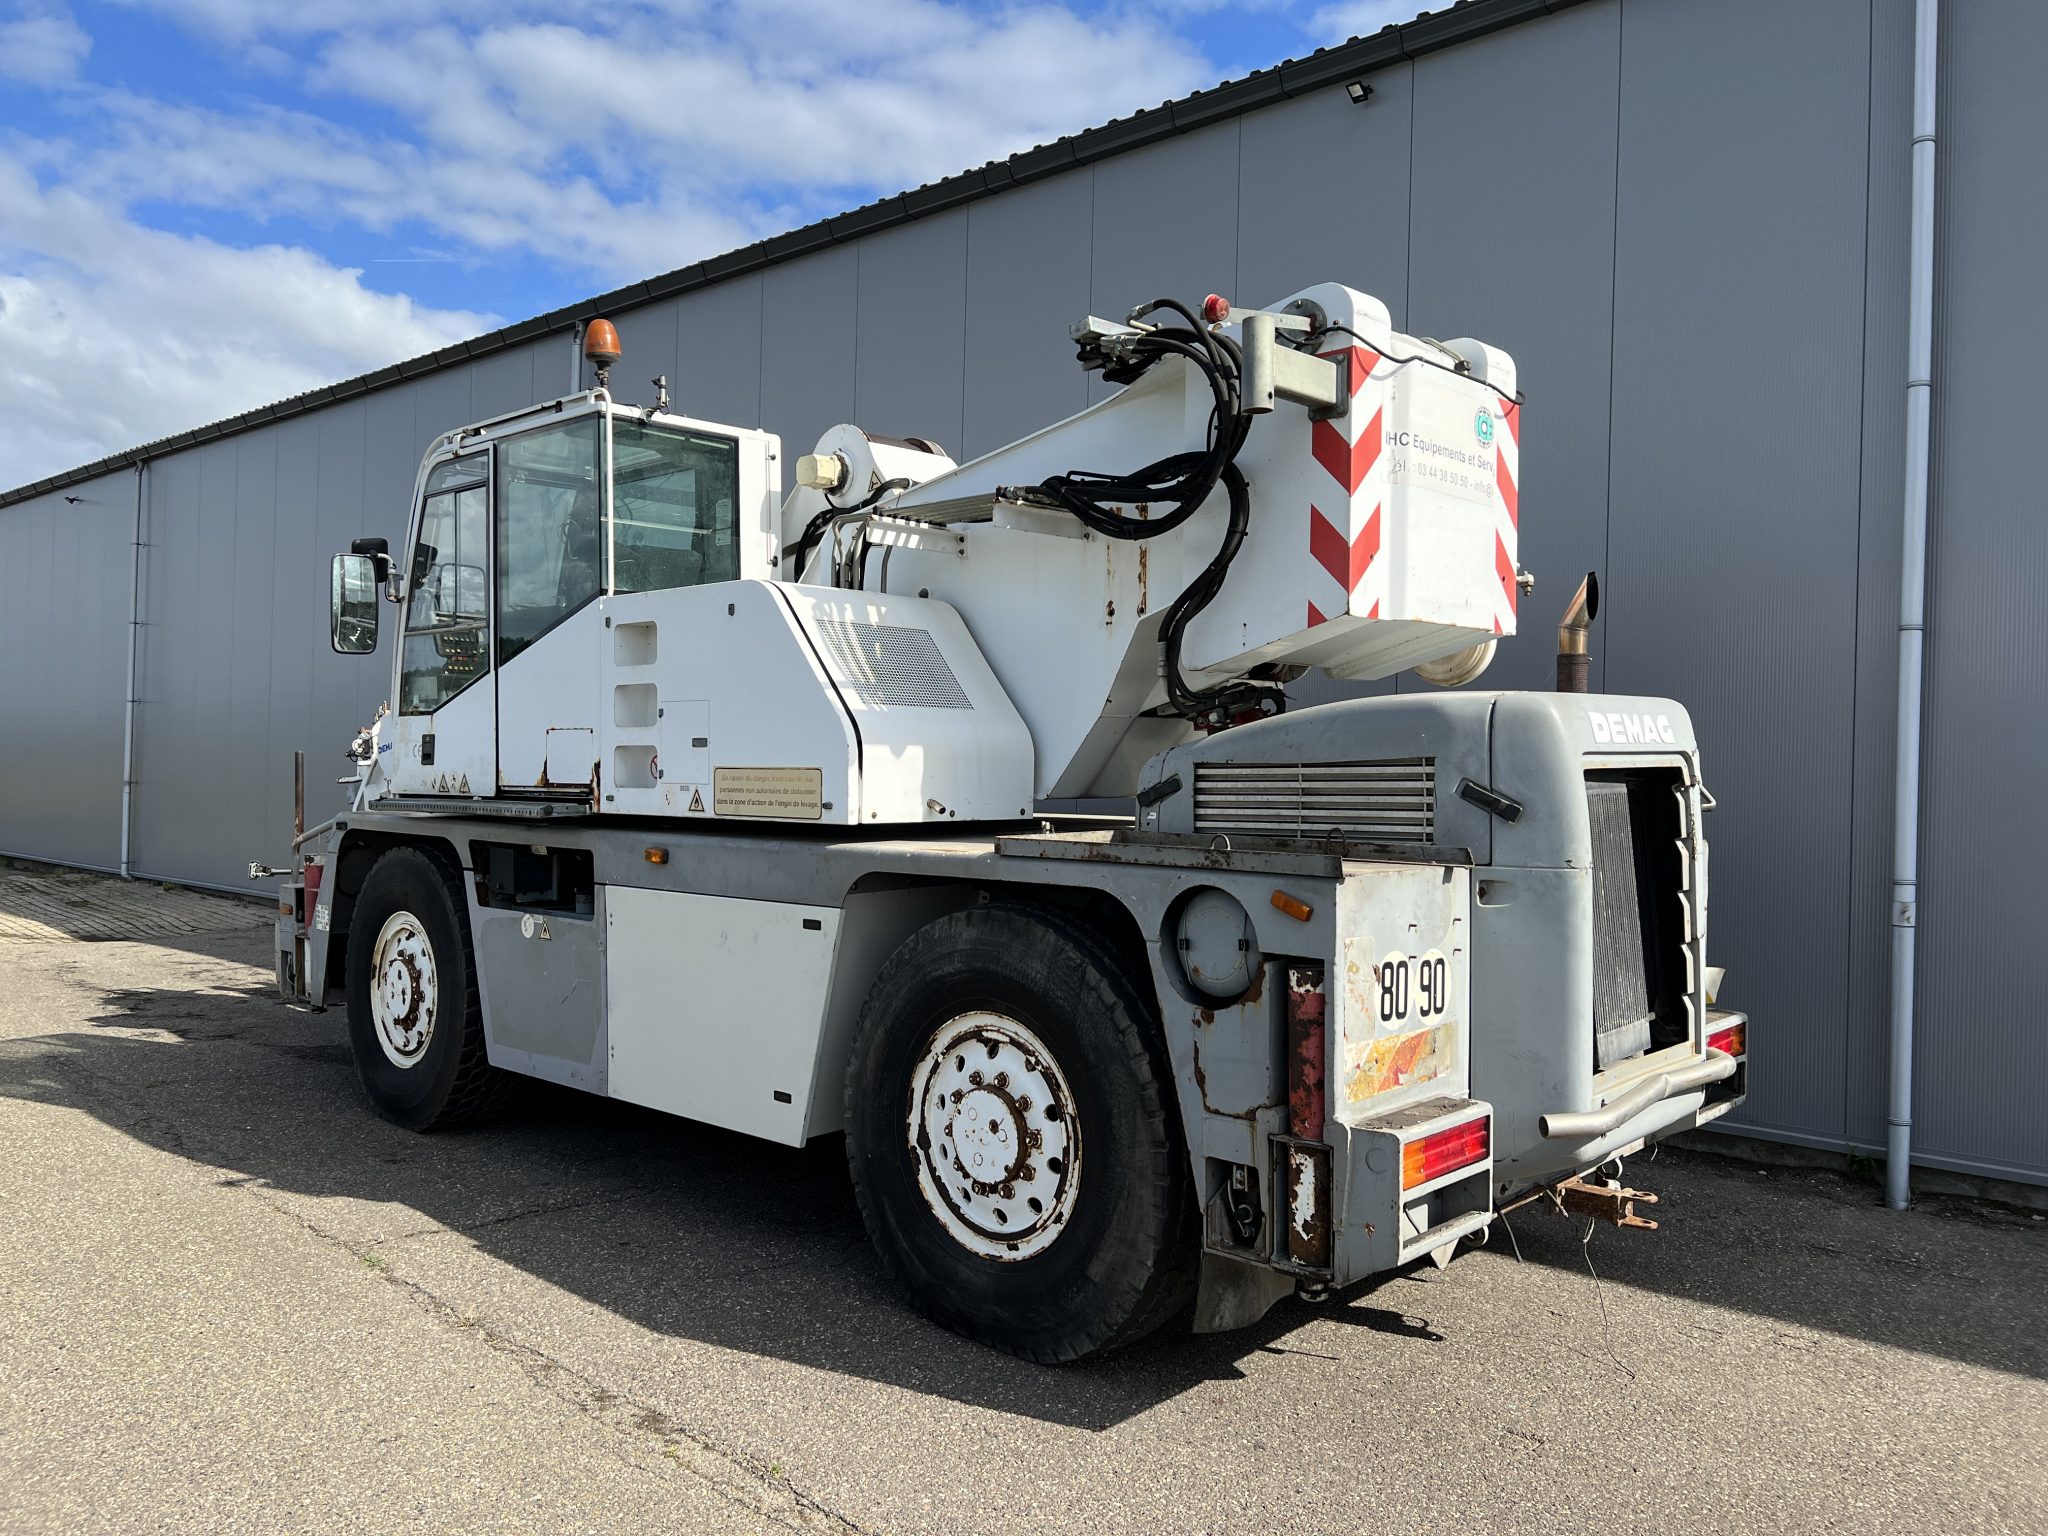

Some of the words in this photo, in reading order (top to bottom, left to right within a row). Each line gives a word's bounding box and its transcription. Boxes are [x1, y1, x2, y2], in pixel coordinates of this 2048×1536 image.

[1385, 431, 1410, 446] IHC
[1413, 434, 1466, 463] Equipements
[1468, 454, 1476, 466] et
[1417, 462, 1427, 476] 03
[1428, 466, 1438, 480] 44
[1439, 469, 1448, 482] 38
[1449, 472, 1459, 486] 50
[1459, 475, 1469, 488] 50
[1588, 711, 1676, 744] DEMAG
[1380, 960, 1409, 1022] 80
[1419, 957, 1446, 1018] 90
